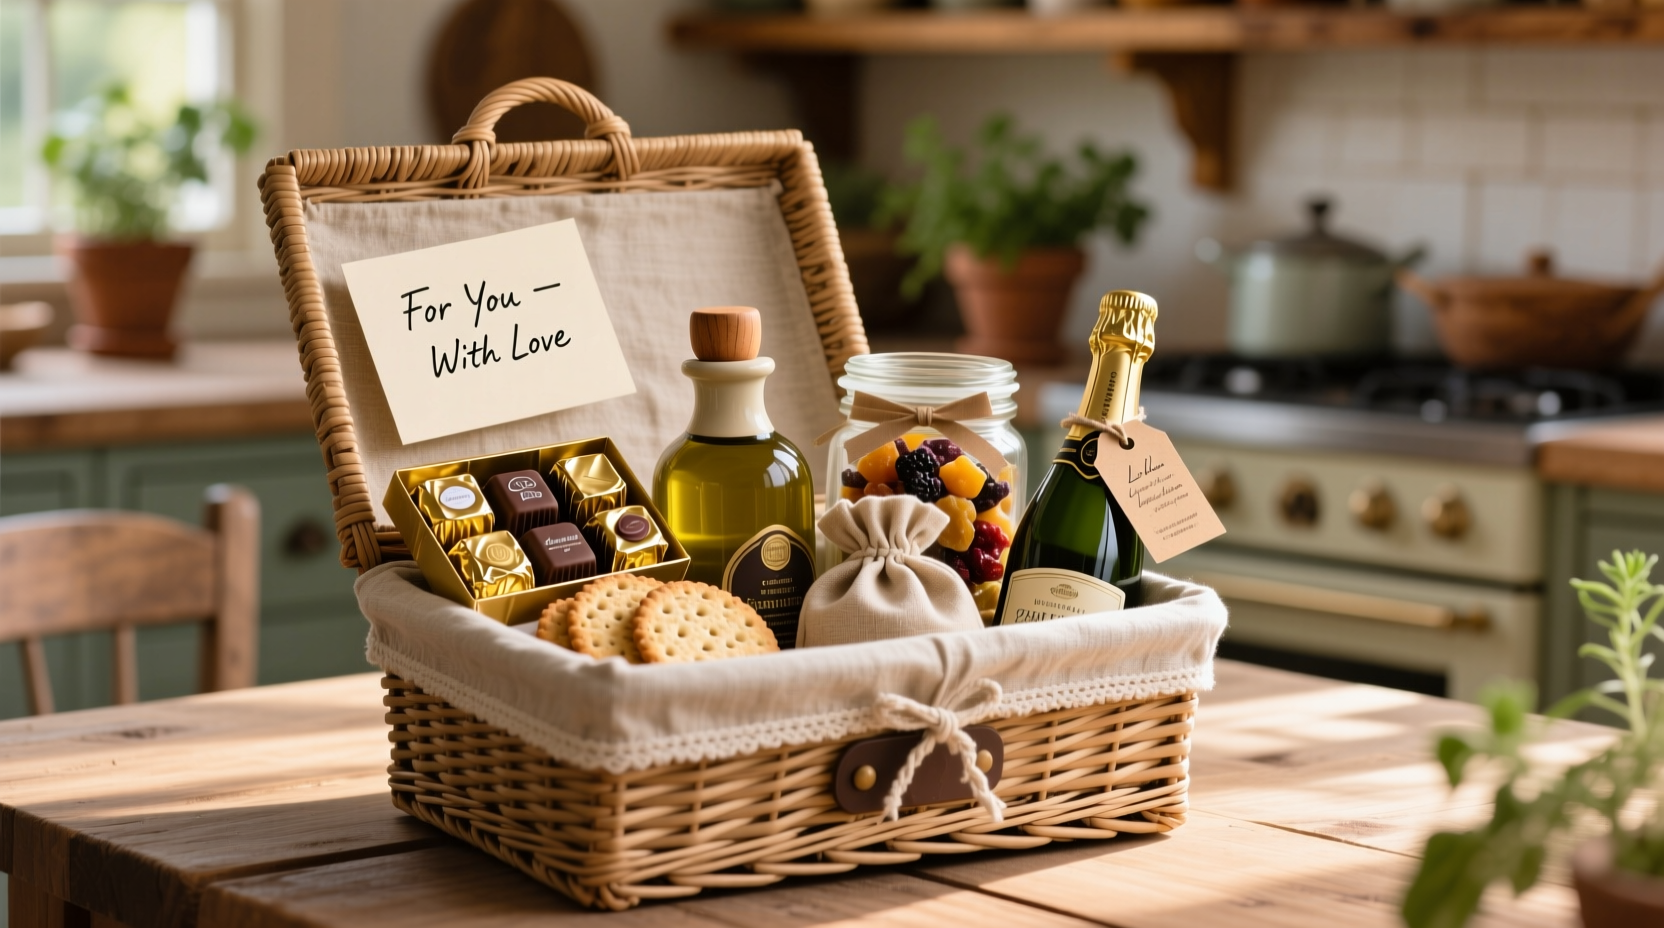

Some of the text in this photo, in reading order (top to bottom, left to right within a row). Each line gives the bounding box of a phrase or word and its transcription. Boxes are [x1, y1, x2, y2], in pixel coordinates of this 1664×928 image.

[400, 286, 452, 331] For
[463, 280, 521, 328] You
[431, 323, 572, 378] With Love
